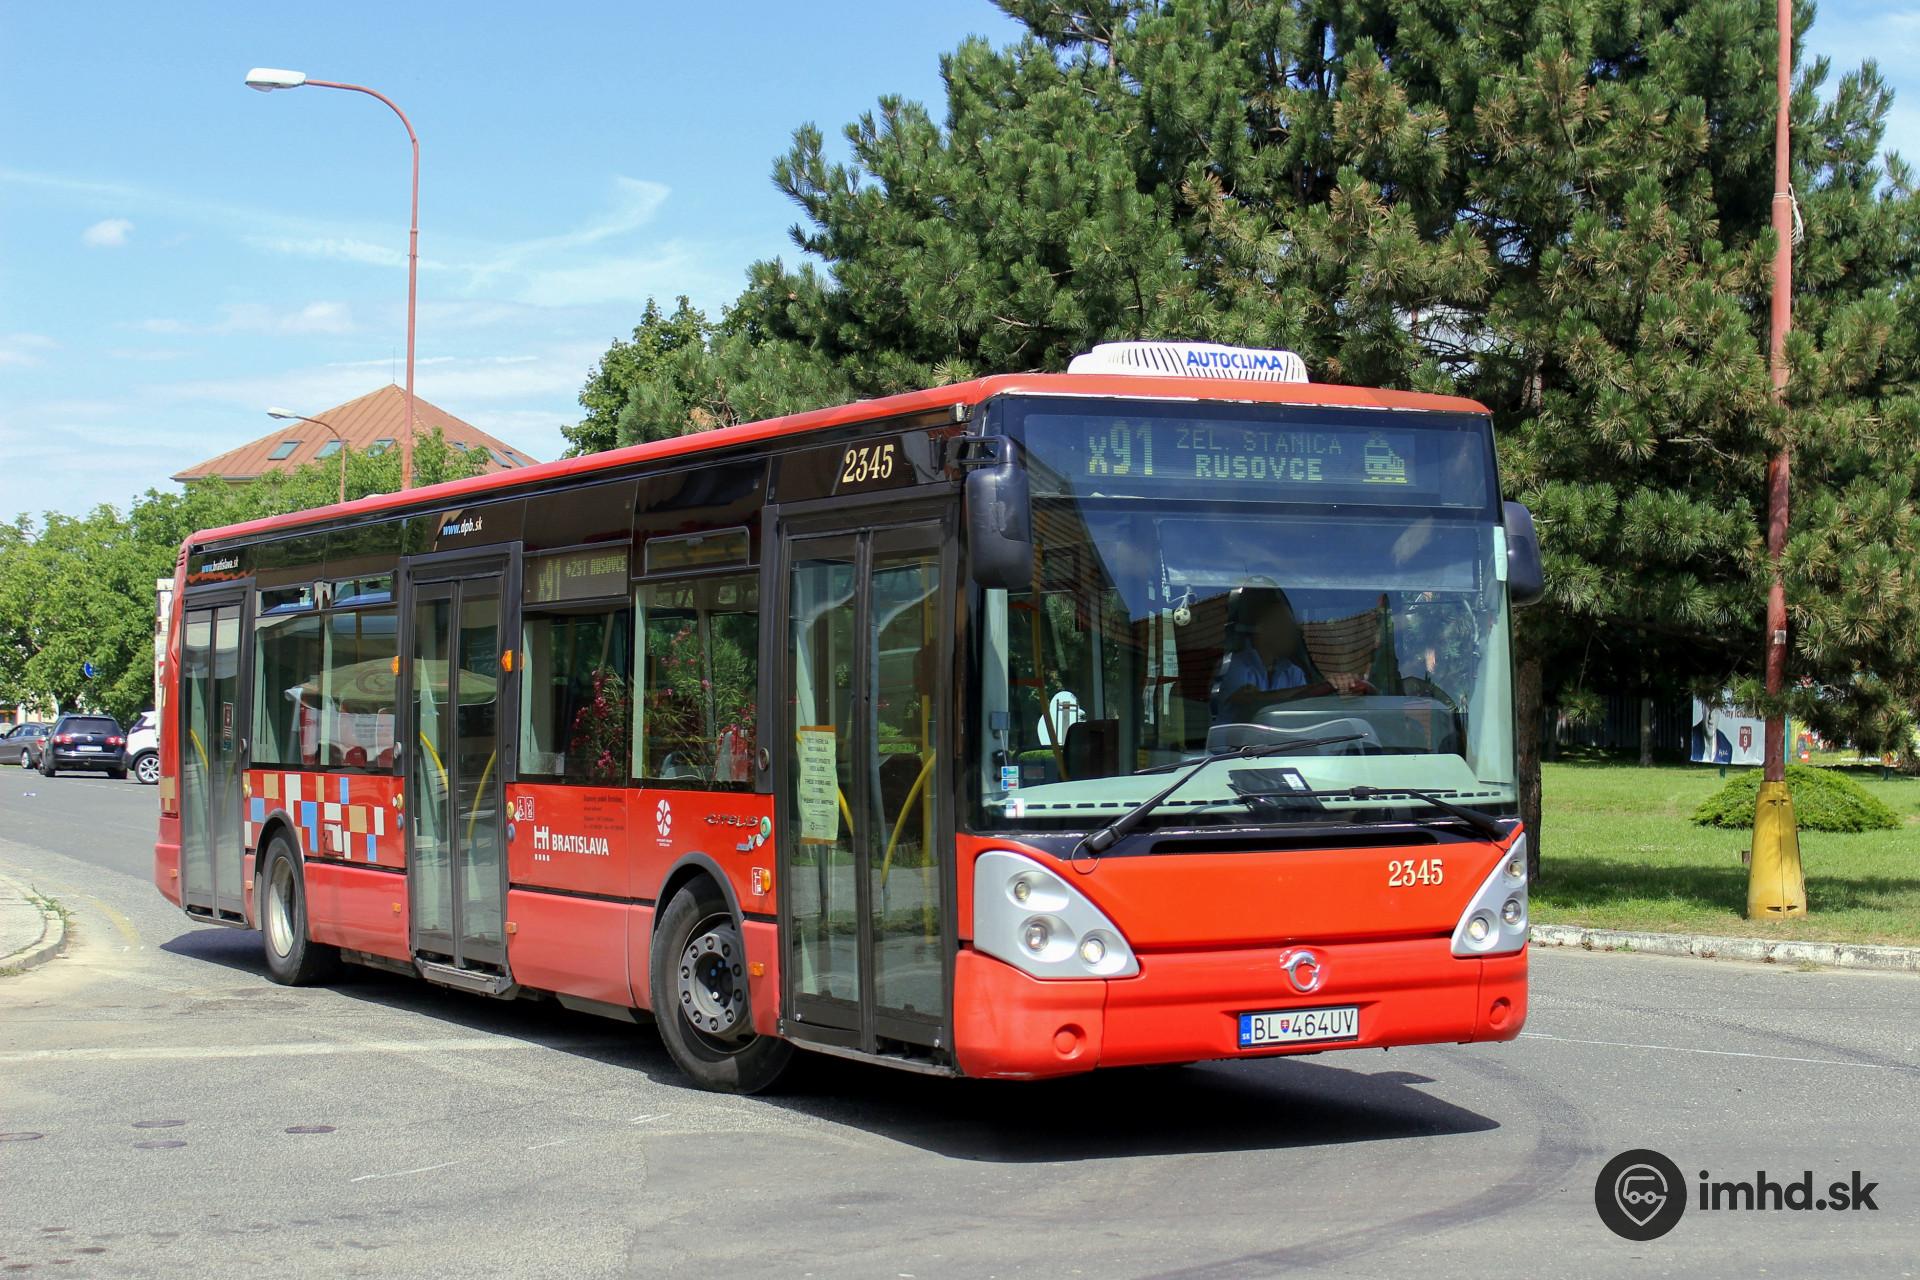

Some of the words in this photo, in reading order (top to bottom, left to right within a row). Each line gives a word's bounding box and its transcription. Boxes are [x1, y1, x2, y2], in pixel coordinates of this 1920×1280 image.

[1186, 350, 1284, 372] AUTOCLIMA
[1243, 430, 1342, 455] STANICA
[842, 444, 895, 483] 2345
[1195, 454, 1323, 481] RUSOVCE
[442, 515, 483, 537] www.dpb.sk
[552, 834, 609, 856] BRATISLAVA
[1388, 858, 1443, 887] 2345
[1254, 1017, 1279, 1041] BL
[1291, 1010, 1354, 1037] 464UV
